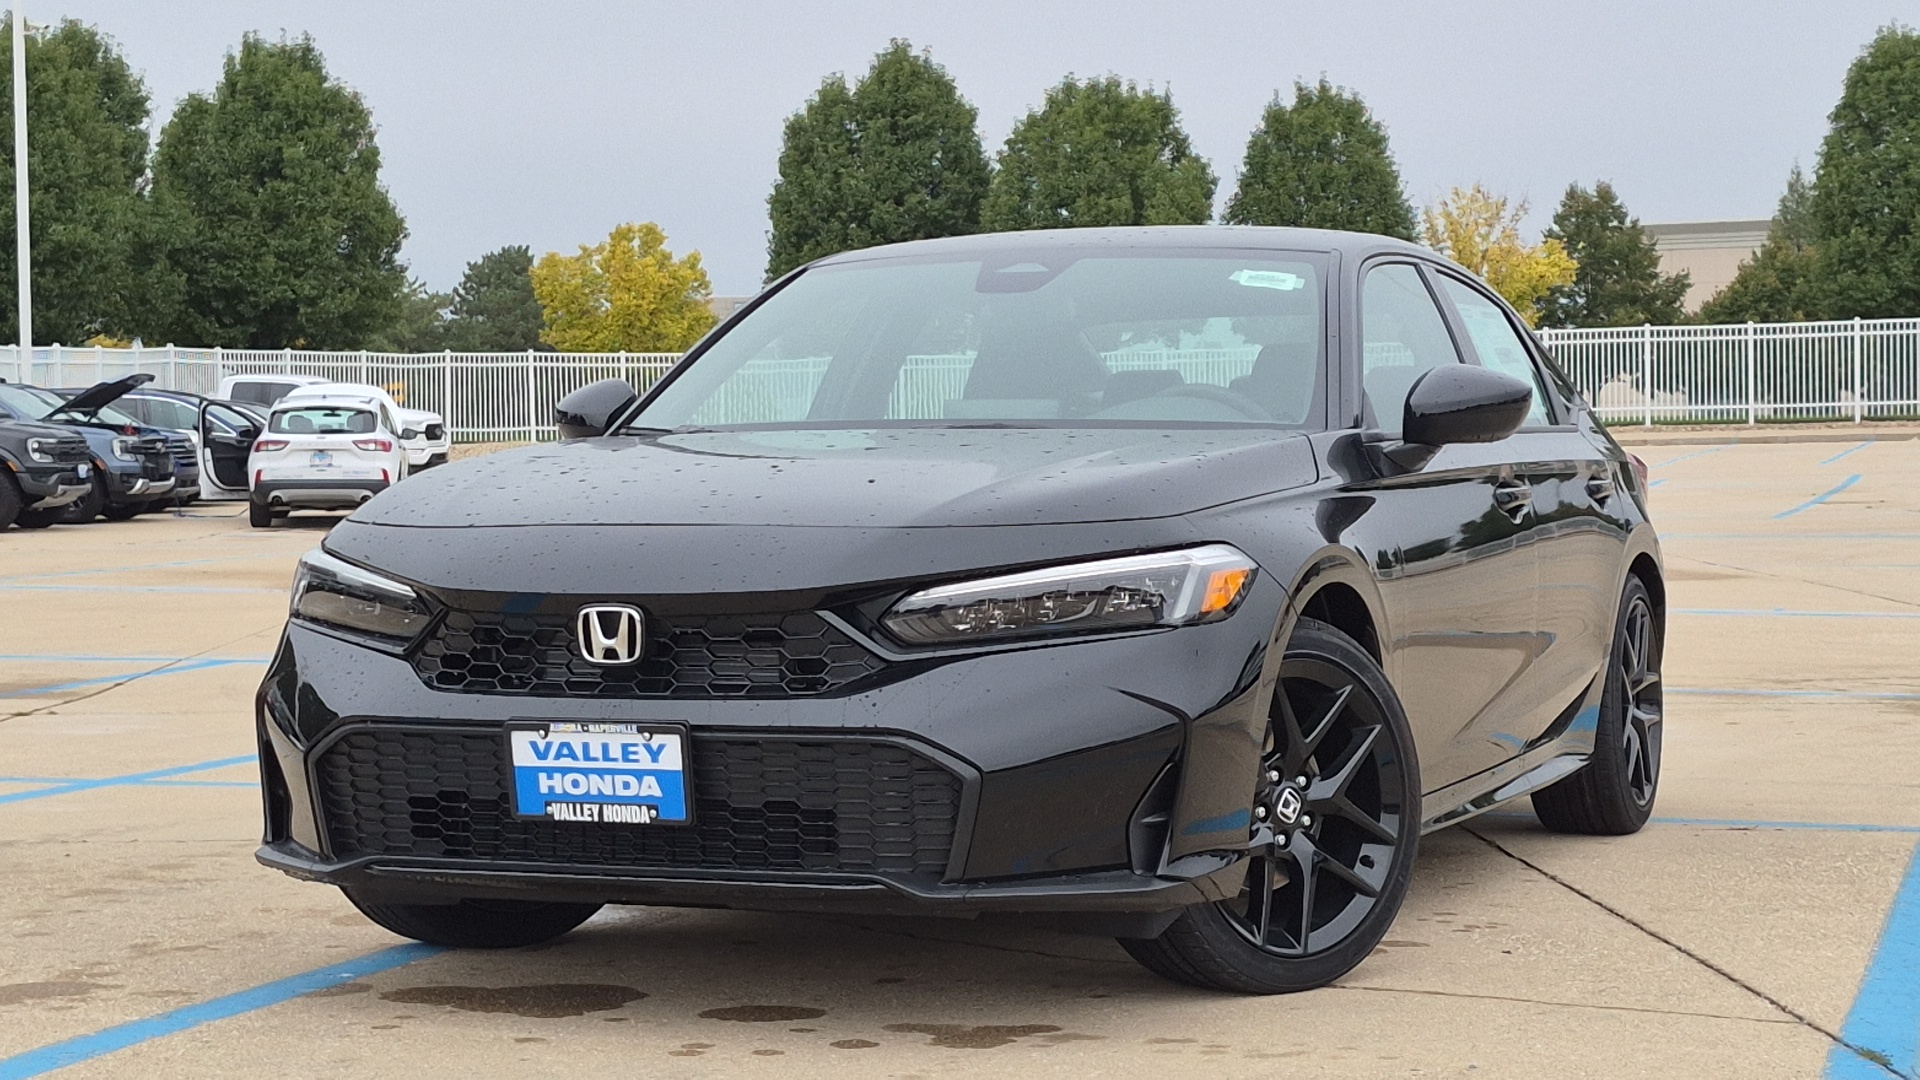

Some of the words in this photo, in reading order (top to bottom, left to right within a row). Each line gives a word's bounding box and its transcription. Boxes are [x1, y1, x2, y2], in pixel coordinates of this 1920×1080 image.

[528, 740, 667, 764] VALLEY
[538, 772, 663, 798] HONDA
[551, 802, 600, 822] VALLEY
[602, 803, 651, 824] HONDA
